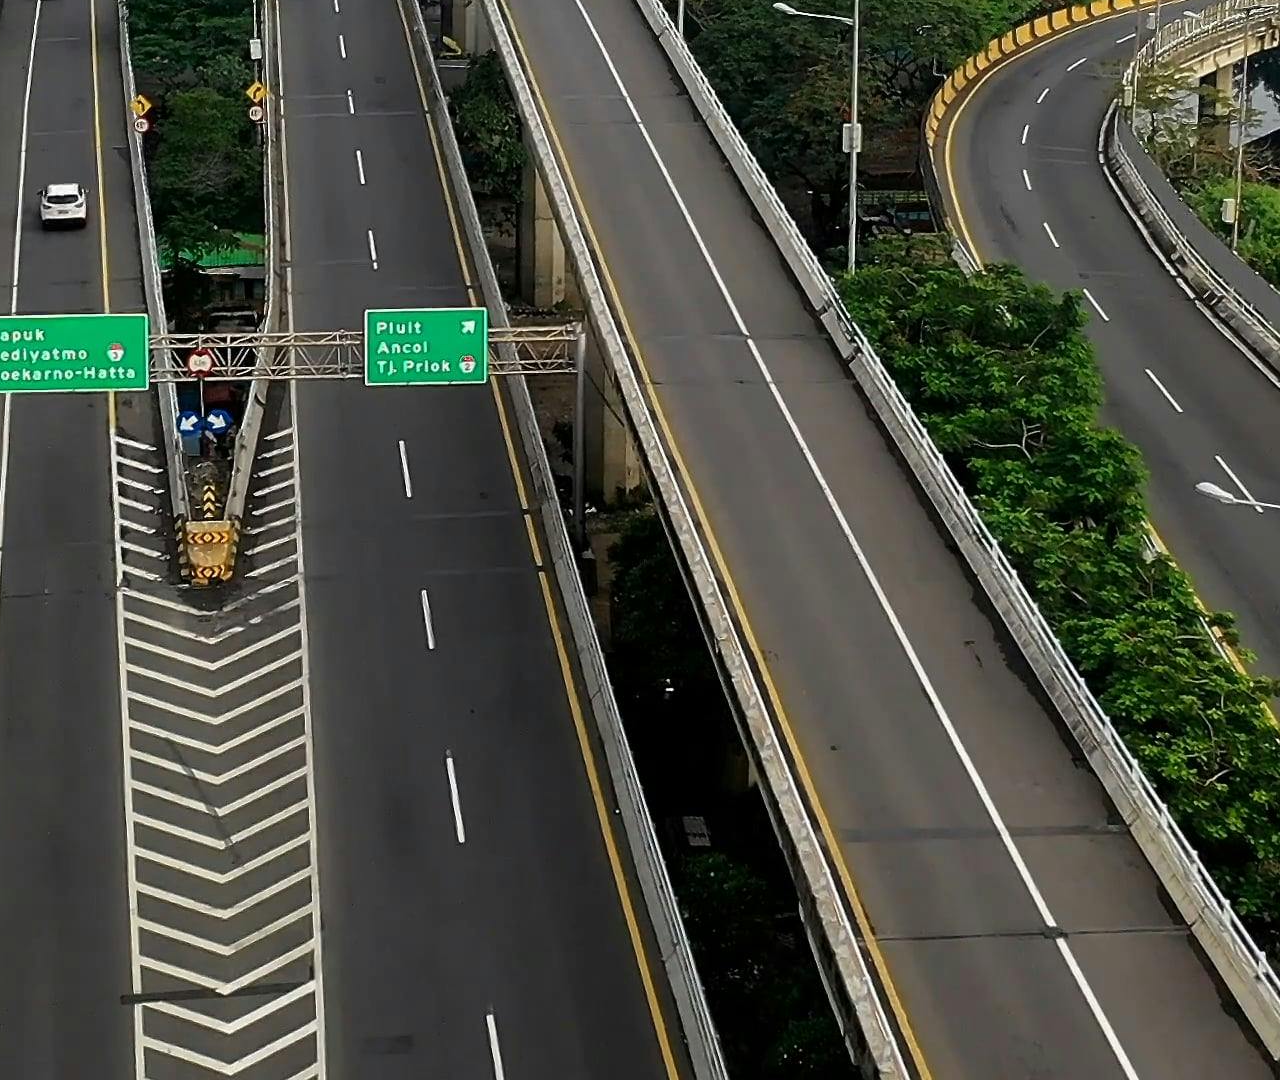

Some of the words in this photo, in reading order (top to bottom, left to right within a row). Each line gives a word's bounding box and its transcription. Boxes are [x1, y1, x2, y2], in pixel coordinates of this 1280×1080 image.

[376, 321, 422, 334] Pluit
[377, 341, 428, 354] Ancol
[376, 360, 398, 376] Tj.
[403, 360, 451, 373] Priok
